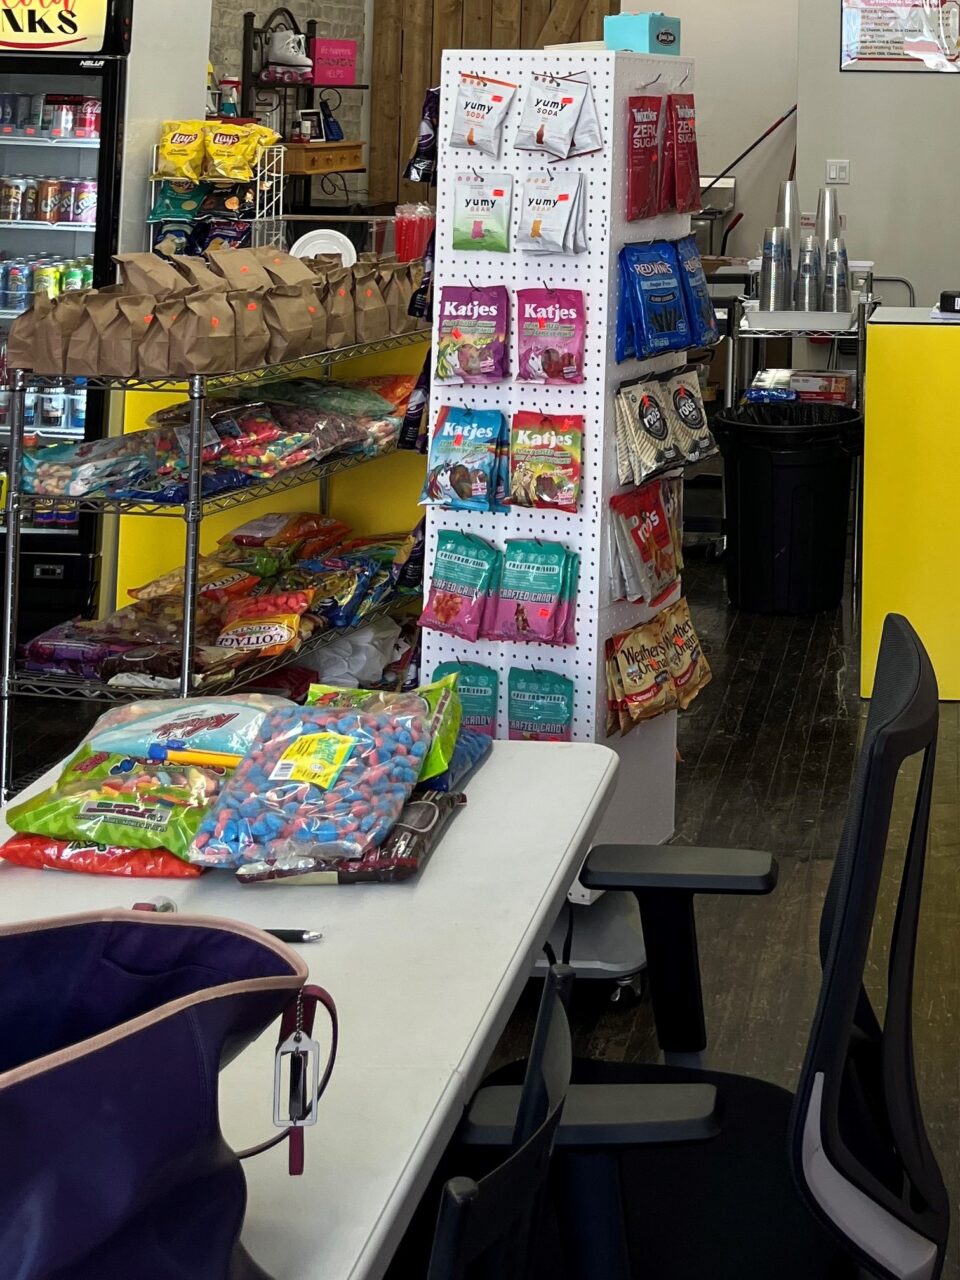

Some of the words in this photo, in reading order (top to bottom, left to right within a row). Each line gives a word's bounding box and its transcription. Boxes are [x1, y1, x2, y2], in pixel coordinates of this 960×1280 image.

[463, 100, 494, 115] yumy
[534, 97, 568, 112] yumy
[466, 110, 486, 120] SODA
[536, 107, 558, 117] SODA
[464, 198, 497, 209] yumy
[528, 197, 559, 209] yumy
[633, 263, 653, 277] RED
[443, 300, 499, 319] Katjes
[523, 303, 578, 322] Katjes
[442, 421, 494, 440] Katjes
[516, 429, 573, 449] Katjes
[500, 588, 530, 601] CRAFTED
[531, 592, 557, 603] CANDY
[465, 715, 492, 726] CANDY
[539, 722, 568, 734] CANDY
